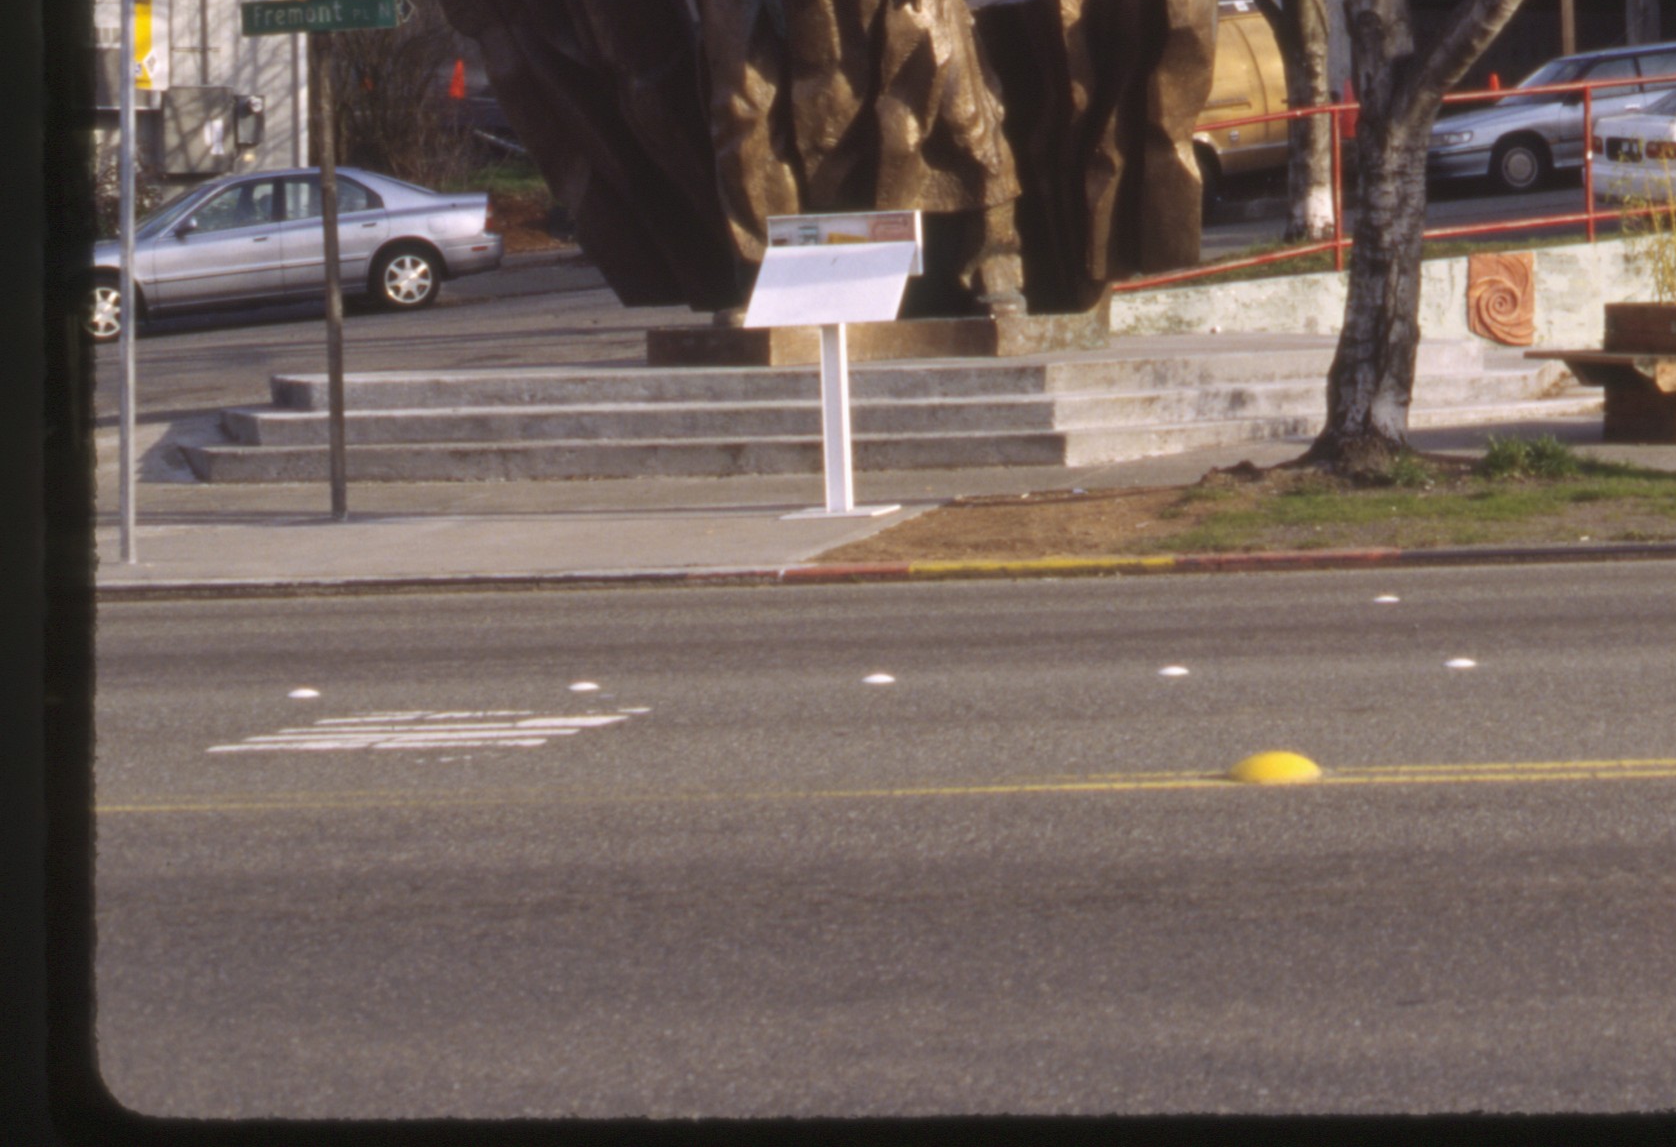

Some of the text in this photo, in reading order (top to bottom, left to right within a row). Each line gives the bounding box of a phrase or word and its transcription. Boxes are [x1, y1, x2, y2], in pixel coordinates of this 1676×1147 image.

[253, 0, 391, 26] Fremont PL N
